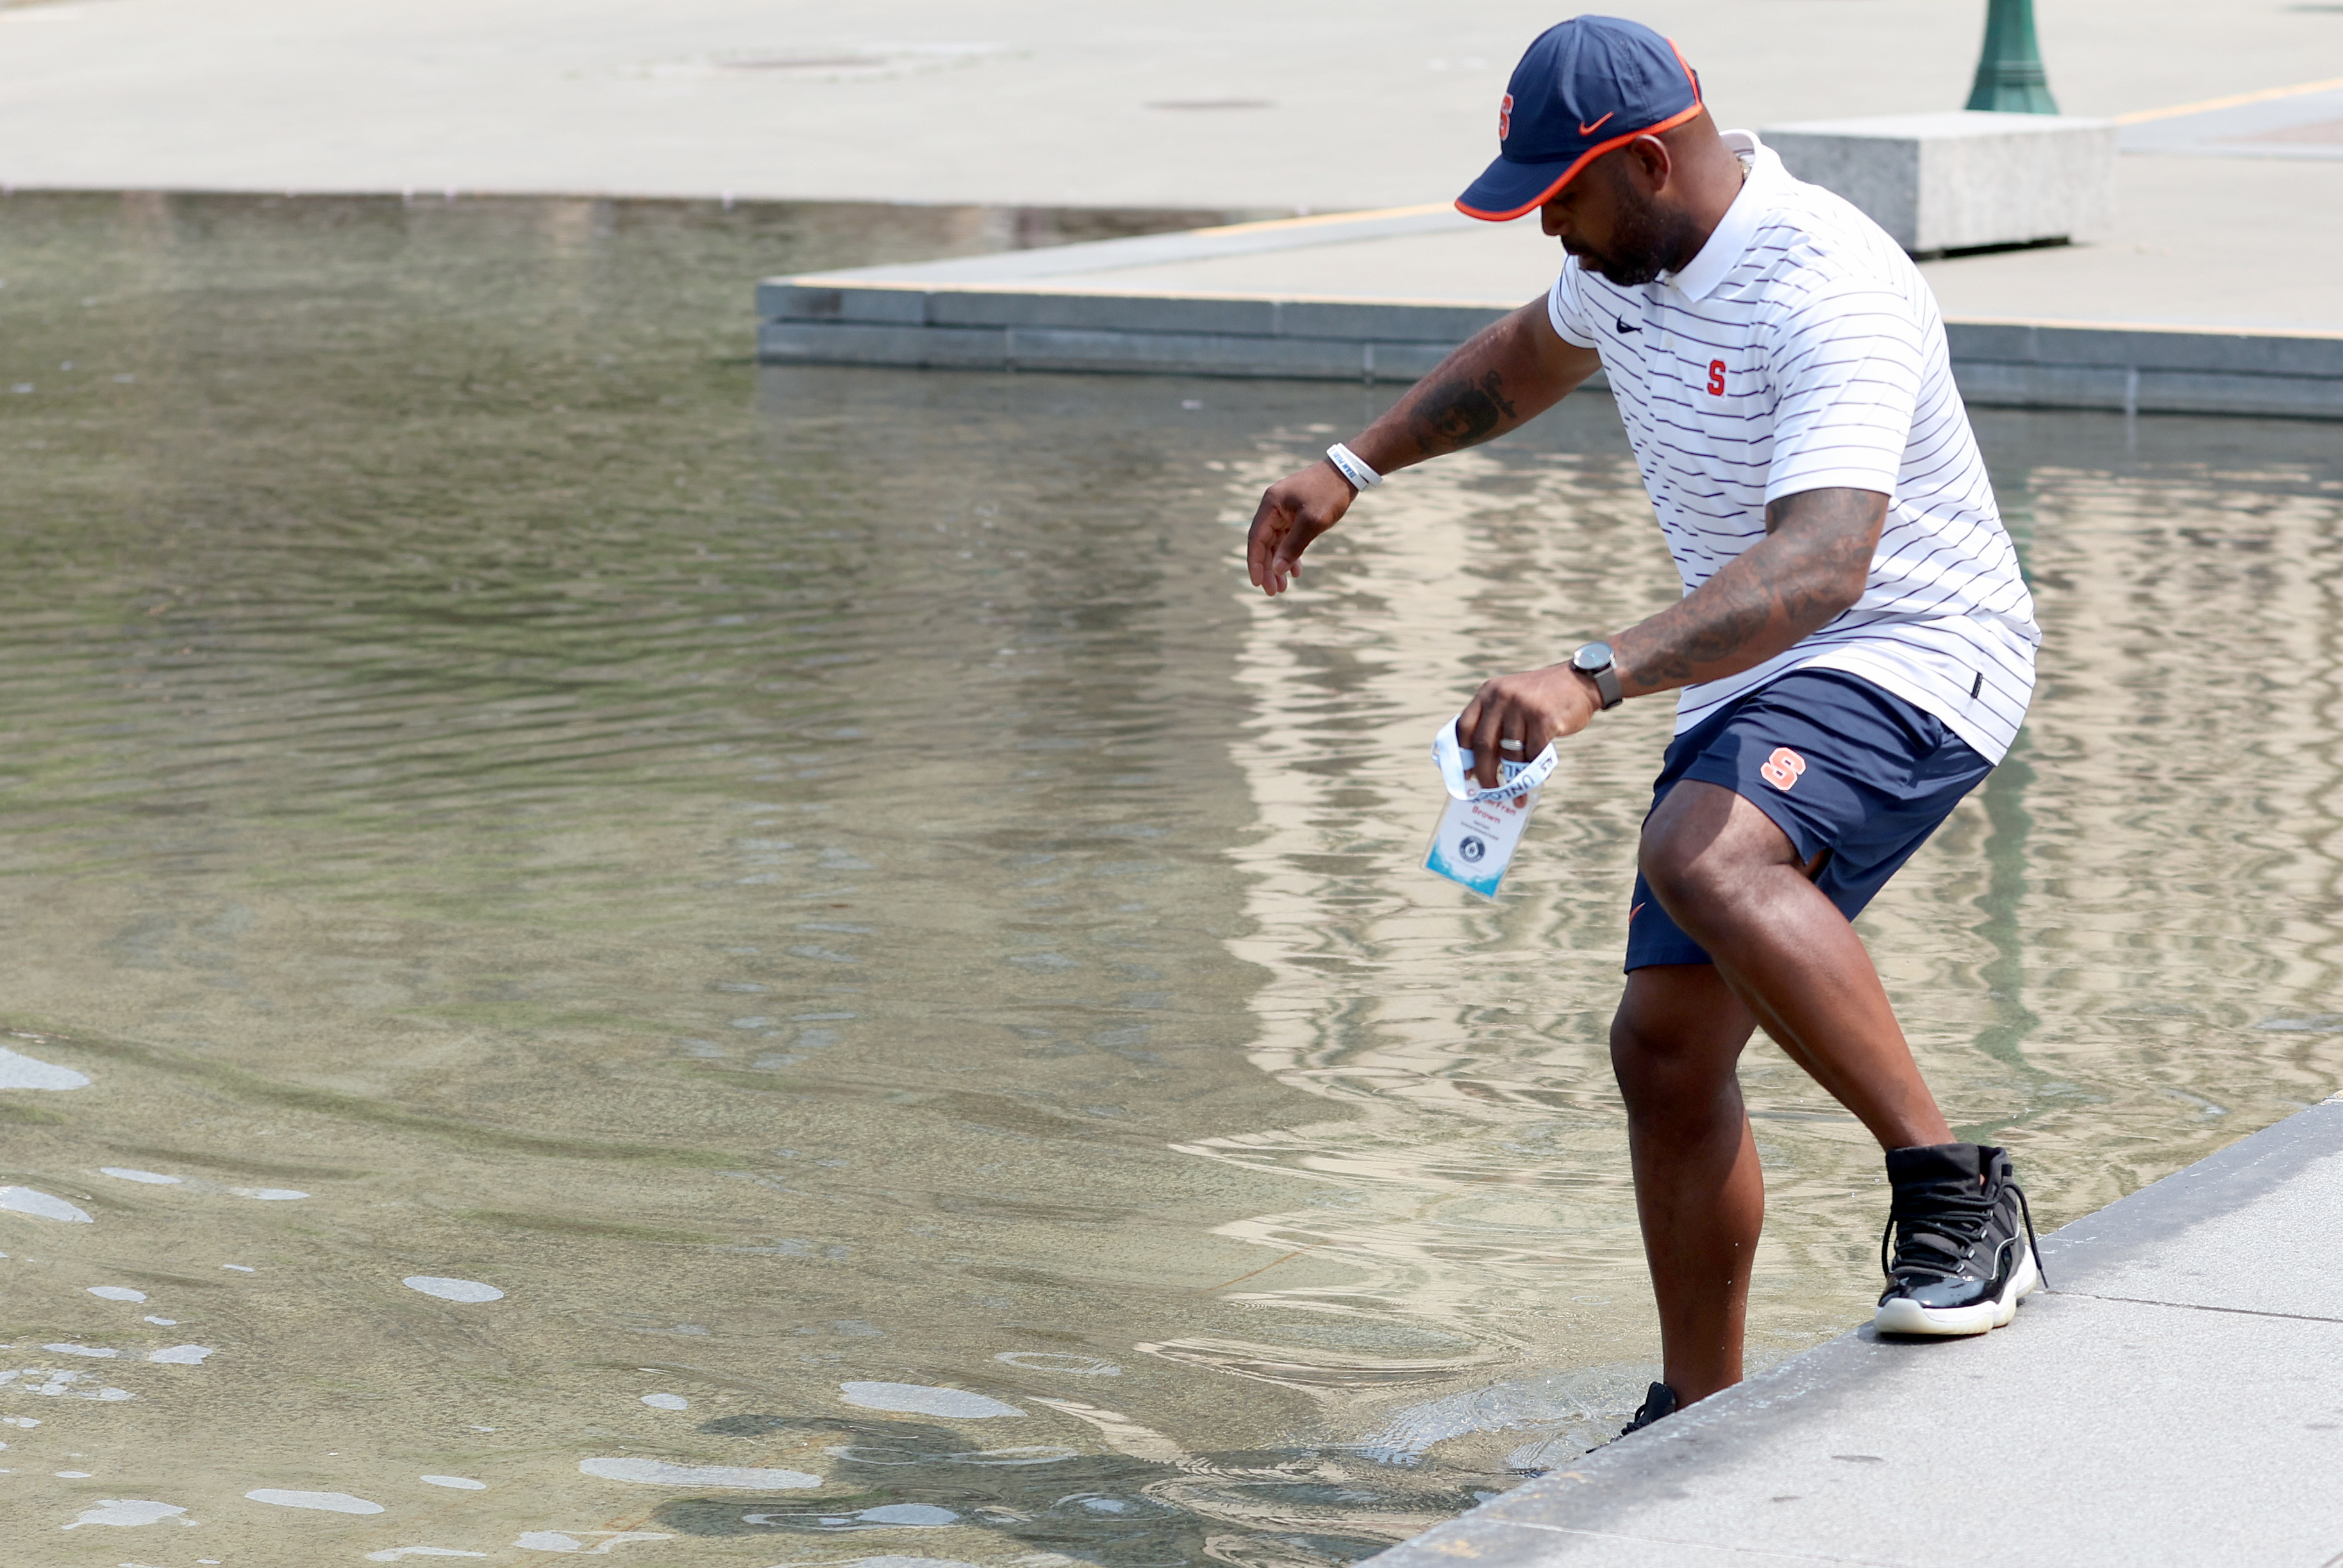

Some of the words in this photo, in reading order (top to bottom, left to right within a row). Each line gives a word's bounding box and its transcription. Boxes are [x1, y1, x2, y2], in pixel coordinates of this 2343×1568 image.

[1499, 93, 1514, 141] S
[1707, 358, 1726, 396] S
[1760, 747, 1806, 790] S
[1472, 805, 1501, 825] Brown
